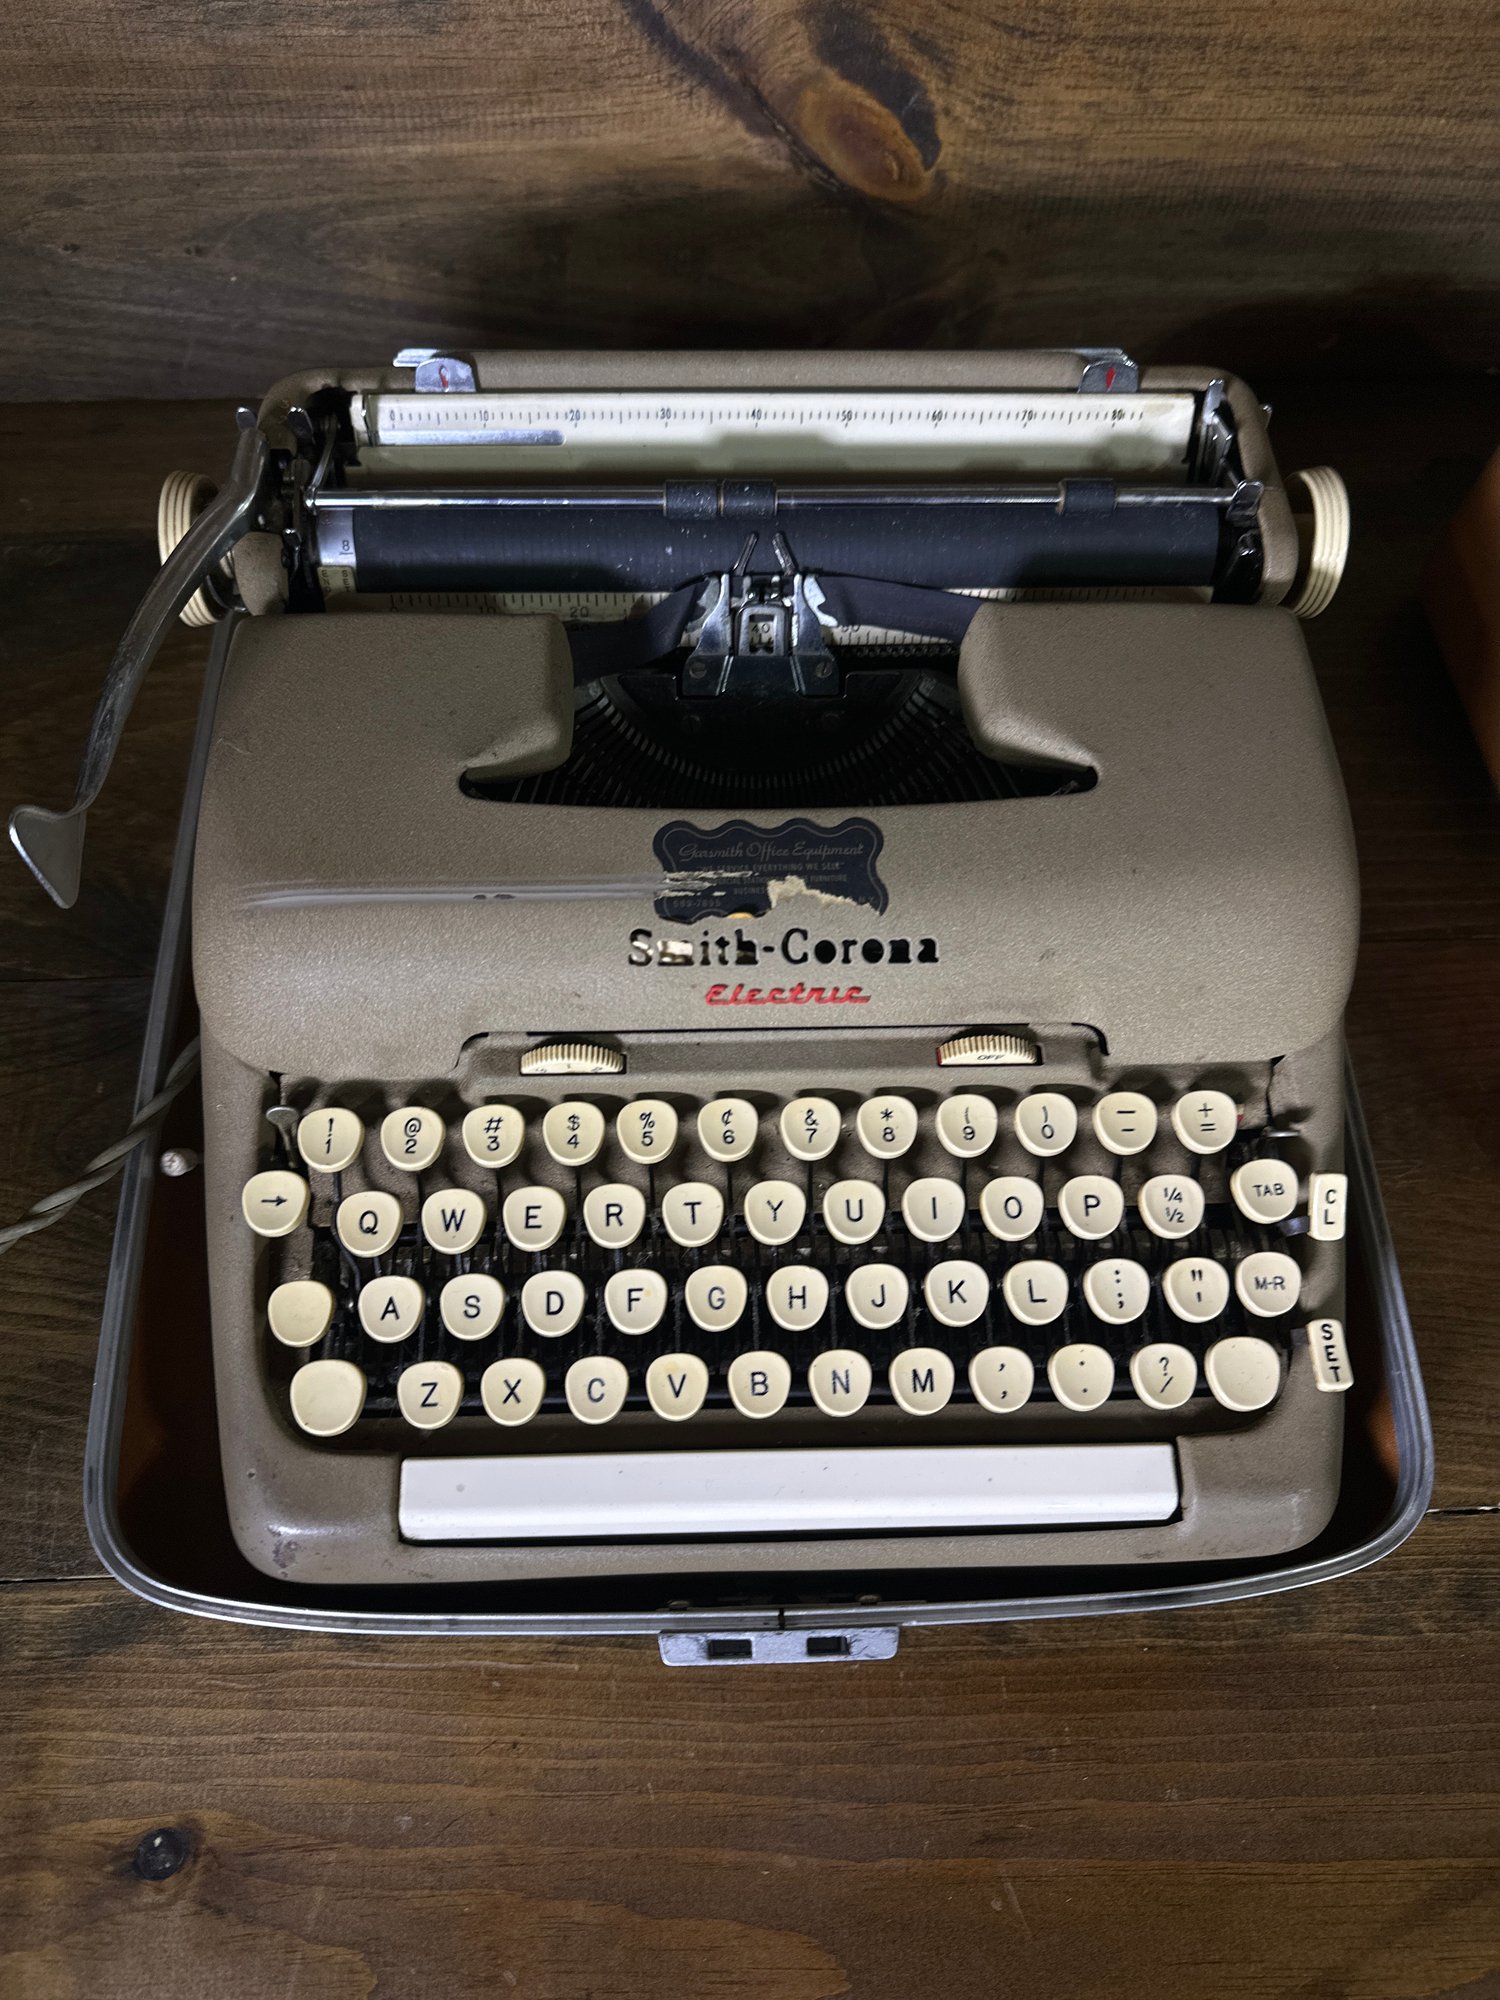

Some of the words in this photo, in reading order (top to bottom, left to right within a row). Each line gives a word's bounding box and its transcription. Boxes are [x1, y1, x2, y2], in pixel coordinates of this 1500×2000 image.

[389, 410, 396, 421] 0
[479, 410, 489, 421] 10
[569, 410, 581, 421] 20
[661, 408, 672, 420] 30
[751, 409, 762, 420] 40
[841, 409, 852, 421] 50
[932, 410, 943, 421] 60
[1023, 409, 1034, 421] 70
[1112, 409, 1124, 421] 80
[570, 606, 589, 617] 20
[746, 841, 790, 862] Office
[792, 841, 865, 860] Equipment
[752, 863, 803, 872] EVERYTHING
[806, 862, 820, 871] WE
[705, 983, 871, 1006] Electric
[722, 1109, 732, 1126] ¢
[805, 1109, 818, 1126] &
[1198, 1104, 1213, 1117] +
[404, 1117, 421, 1137] @
[484, 1117, 503, 1133] #
[567, 1114, 580, 1131] $
[640, 1112, 655, 1129] %
[1200, 1123, 1216, 1131] =
[642, 1131, 653, 1146] 5
[723, 1130, 735, 1144] 6
[806, 1128, 817, 1143] 7
[883, 1127, 895, 1142] 8
[963, 1126, 975, 1140] 9
[1041, 1124, 1054, 1139] 0
[405, 1139, 417, 1154] 2
[487, 1136, 500, 1151] 3
[567, 1134, 579, 1148] 4
[1253, 1183, 1284, 1197] TAB
[683, 1202, 701, 1225] T
[767, 1200, 783, 1221] Y
[846, 1199, 863, 1222] U
[1004, 1196, 1022, 1219] O
[1084, 1195, 1100, 1217] P
[359, 1210, 378, 1235] Q
[441, 1209, 465, 1232] W
[524, 1206, 542, 1229] E
[606, 1203, 623, 1227] R
[1028, 1279, 1047, 1303] L
[1255, 1276, 1285, 1290] M-R
[628, 1288, 643, 1312] F
[708, 1287, 725, 1310] G
[789, 1286, 806, 1309] H
[871, 1285, 885, 1308] J
[948, 1280, 966, 1304] K
[380, 1297, 399, 1321] A
[463, 1295, 480, 1319] S
[546, 1291, 564, 1315] D
[1160, 1357, 1169, 1376] ?
[668, 1374, 686, 1398] V
[751, 1371, 768, 1396] B
[832, 1370, 850, 1394] N
[912, 1369, 934, 1393] M
[1160, 1376, 1174, 1393] /
[421, 1382, 438, 1408] Z
[502, 1379, 521, 1404] X
[587, 1378, 605, 1403] C
